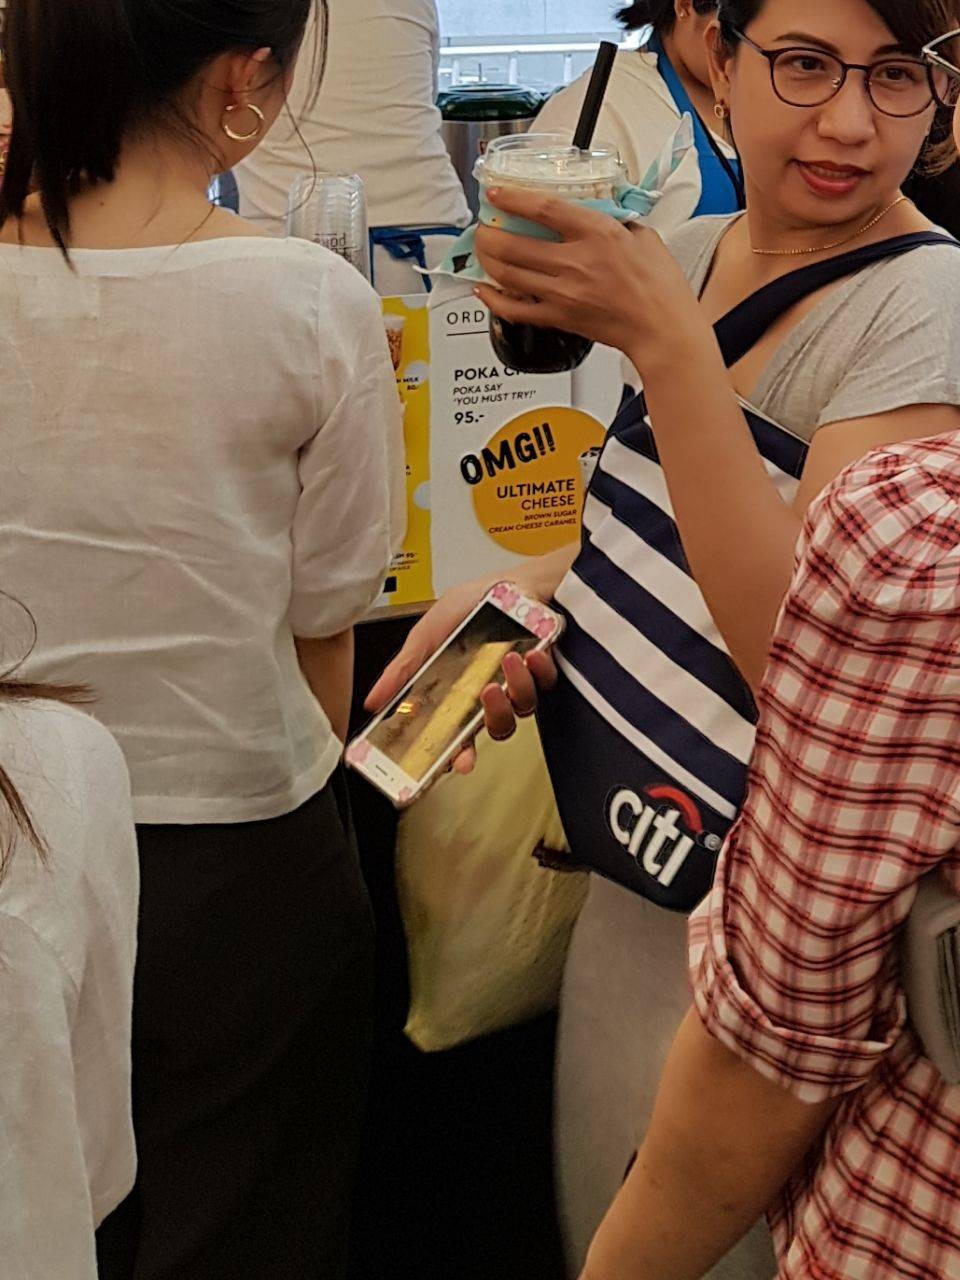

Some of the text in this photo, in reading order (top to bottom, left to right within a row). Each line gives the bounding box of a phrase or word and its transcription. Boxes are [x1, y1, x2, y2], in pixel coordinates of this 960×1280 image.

[446, 310, 485, 325] ORD
[454, 366, 499, 382] POKA
[453, 383, 503, 395] POKA SAY
[481, 393, 509, 403] MUST
[460, 422, 556, 485] OMG!!
[496, 479, 576, 499] ULTIMATE
[521, 495, 575, 511] CHEESE
[524, 509, 577, 522] BROWN SUGAR
[488, 526, 515, 535] CREAM
[515, 522, 543, 531] CHEESE
[609, 788, 695, 888] citi
